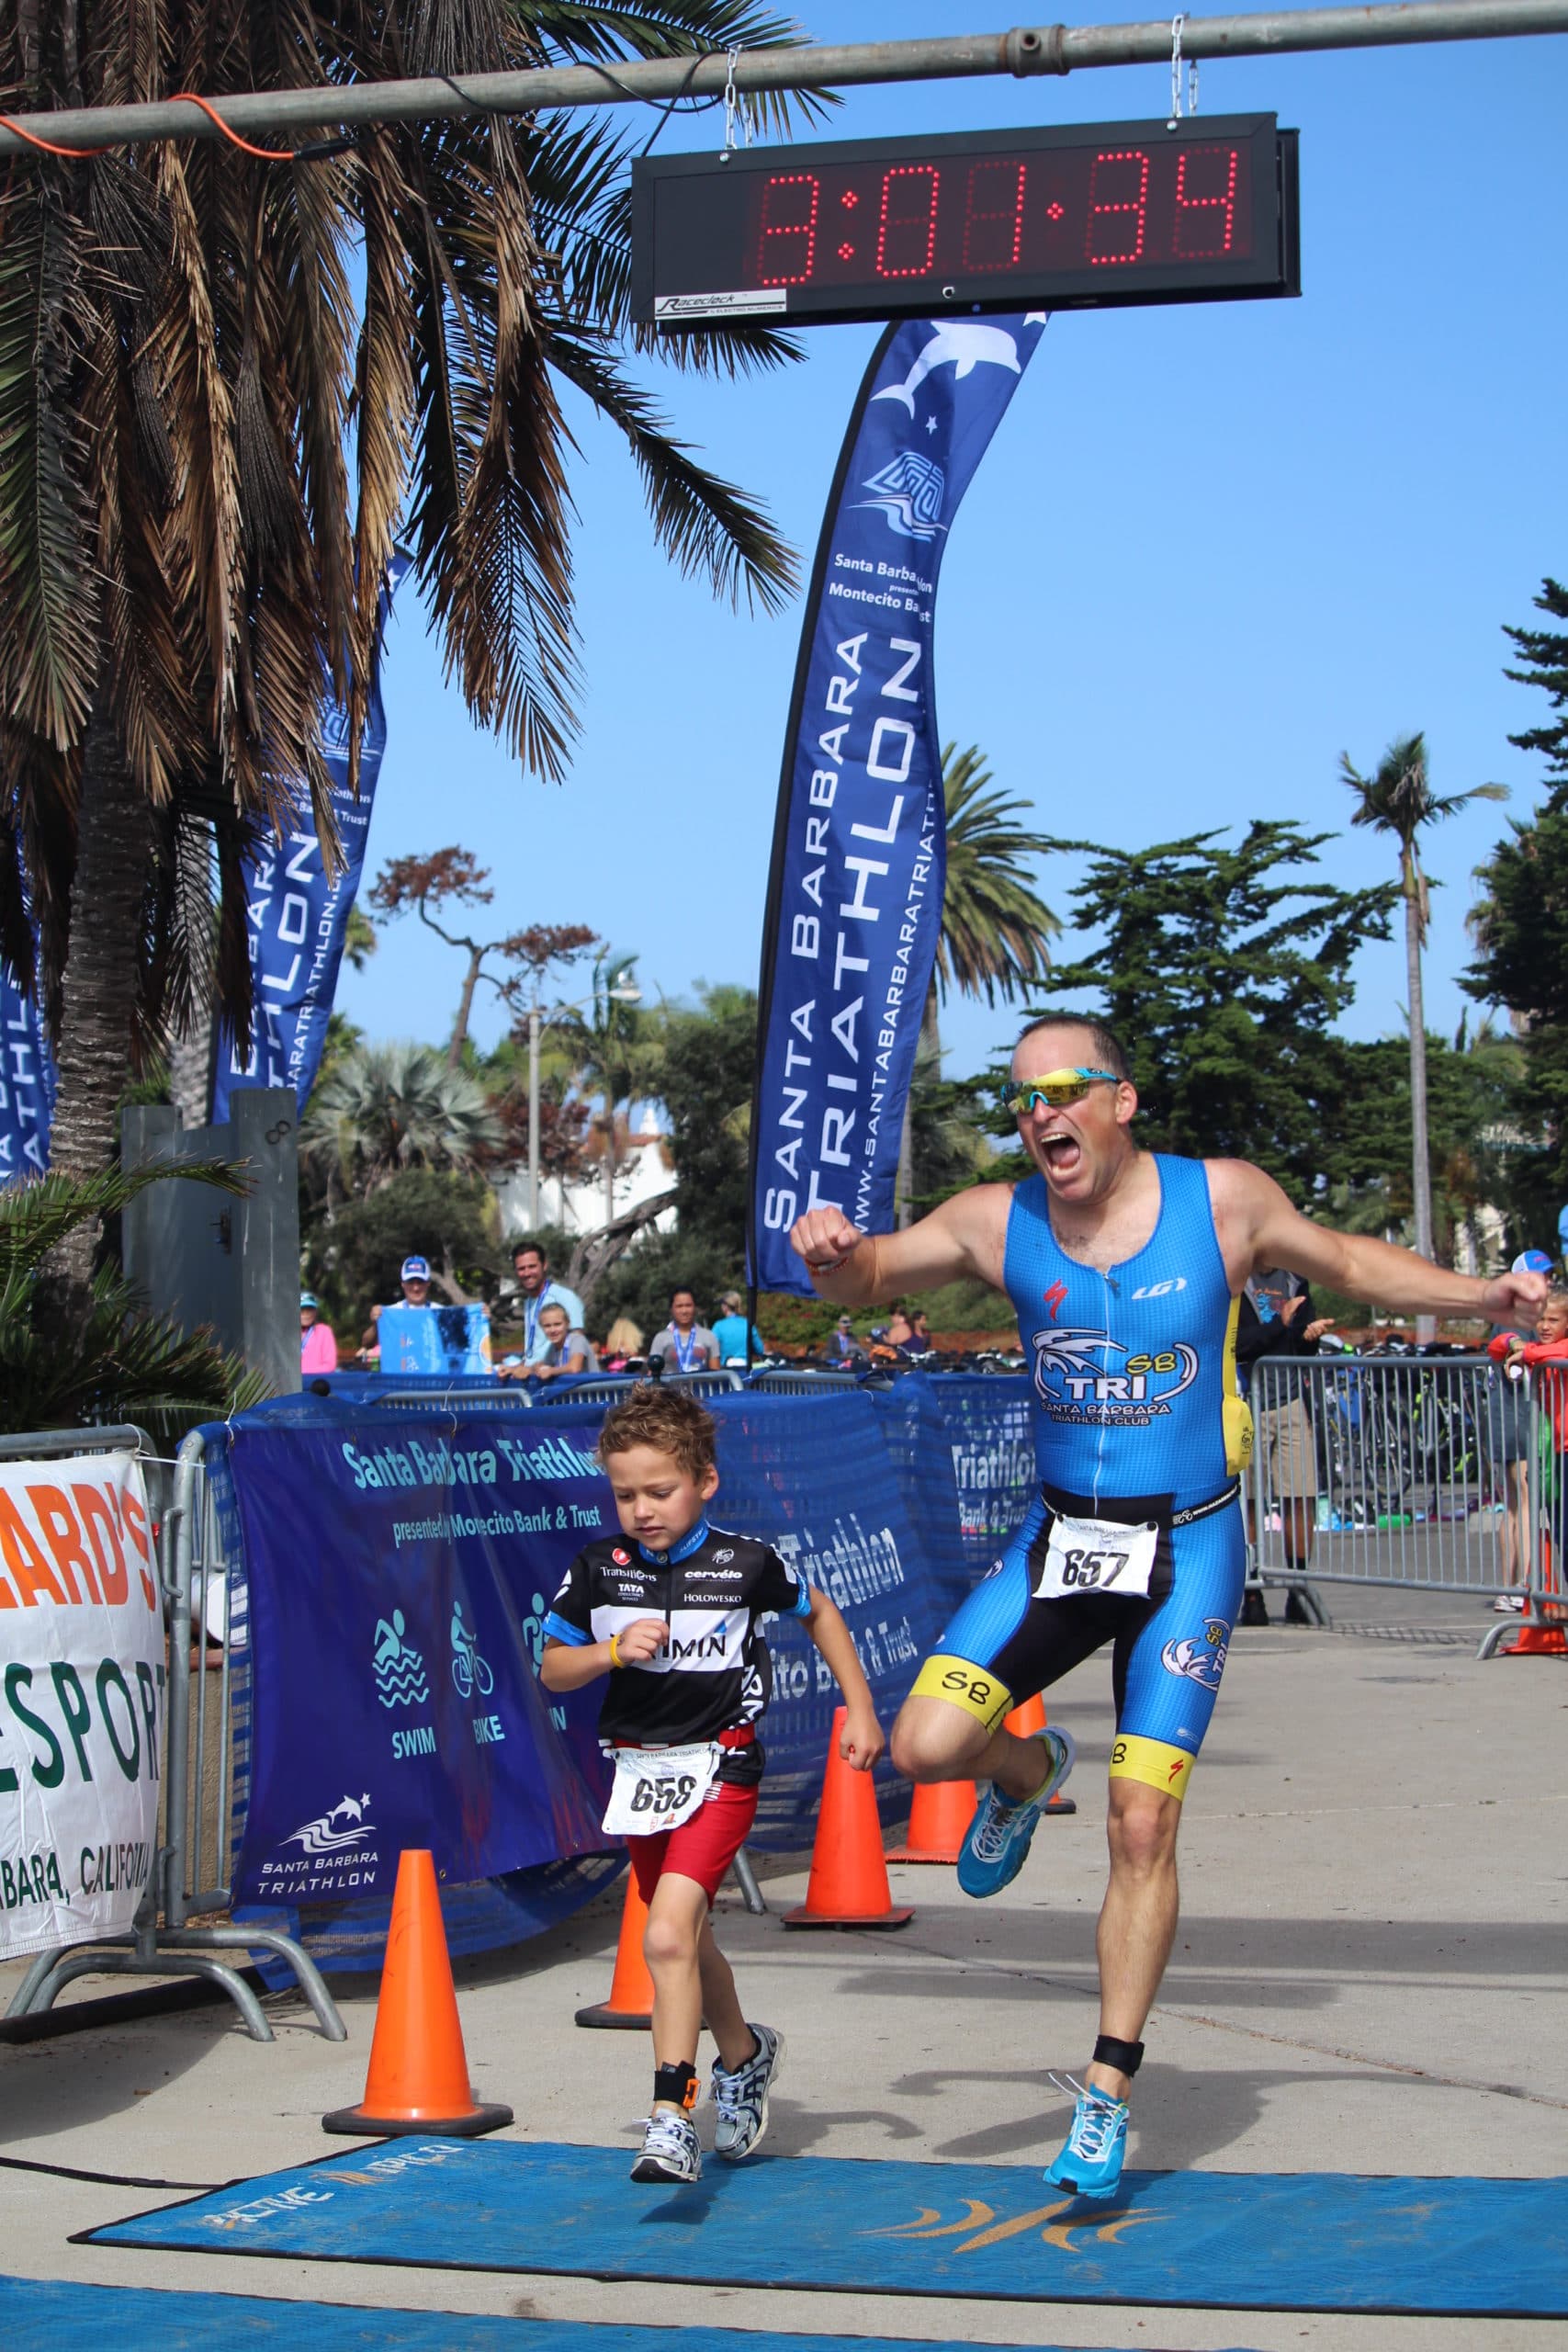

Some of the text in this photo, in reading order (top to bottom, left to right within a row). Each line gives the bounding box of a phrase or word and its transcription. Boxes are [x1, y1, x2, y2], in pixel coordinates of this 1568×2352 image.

[834, 553, 917, 582] Santa Barba
[829, 582, 902, 609] Montecito
[341, 810, 367, 826] Trust
[764, 632, 869, 1233] SANTA BARBARA
[807, 637, 922, 1216] TRIATHLON
[1126, 1351, 1177, 1375] SB
[1065, 1375, 1146, 1400] TRI
[1041, 1402, 1172, 1416] SANTA BARBARA
[1051, 1414, 1150, 1426] TRIATHLON CLUB
[342, 1442, 417, 1489] Santa
[408, 1438, 497, 1486] Barbara
[513, 1506, 552, 1533] Bank
[556, 1506, 568, 1530] &
[569, 1505, 602, 1528] Trust
[600, 1566, 743, 1582] Transitions cervélo
[1062, 1549, 1130, 1588] 657
[618, 1583, 645, 1594] TATA
[683, 1593, 742, 1603] HOLOWESKO
[942, 1670, 991, 1705] SB
[392, 1715, 506, 1759] SWIM BIKE
[262, 1851, 379, 1874] SANTA BARBARA
[0, 1851, 71, 1910] BARA,
[257, 1871, 377, 1895] TRIATHLON
